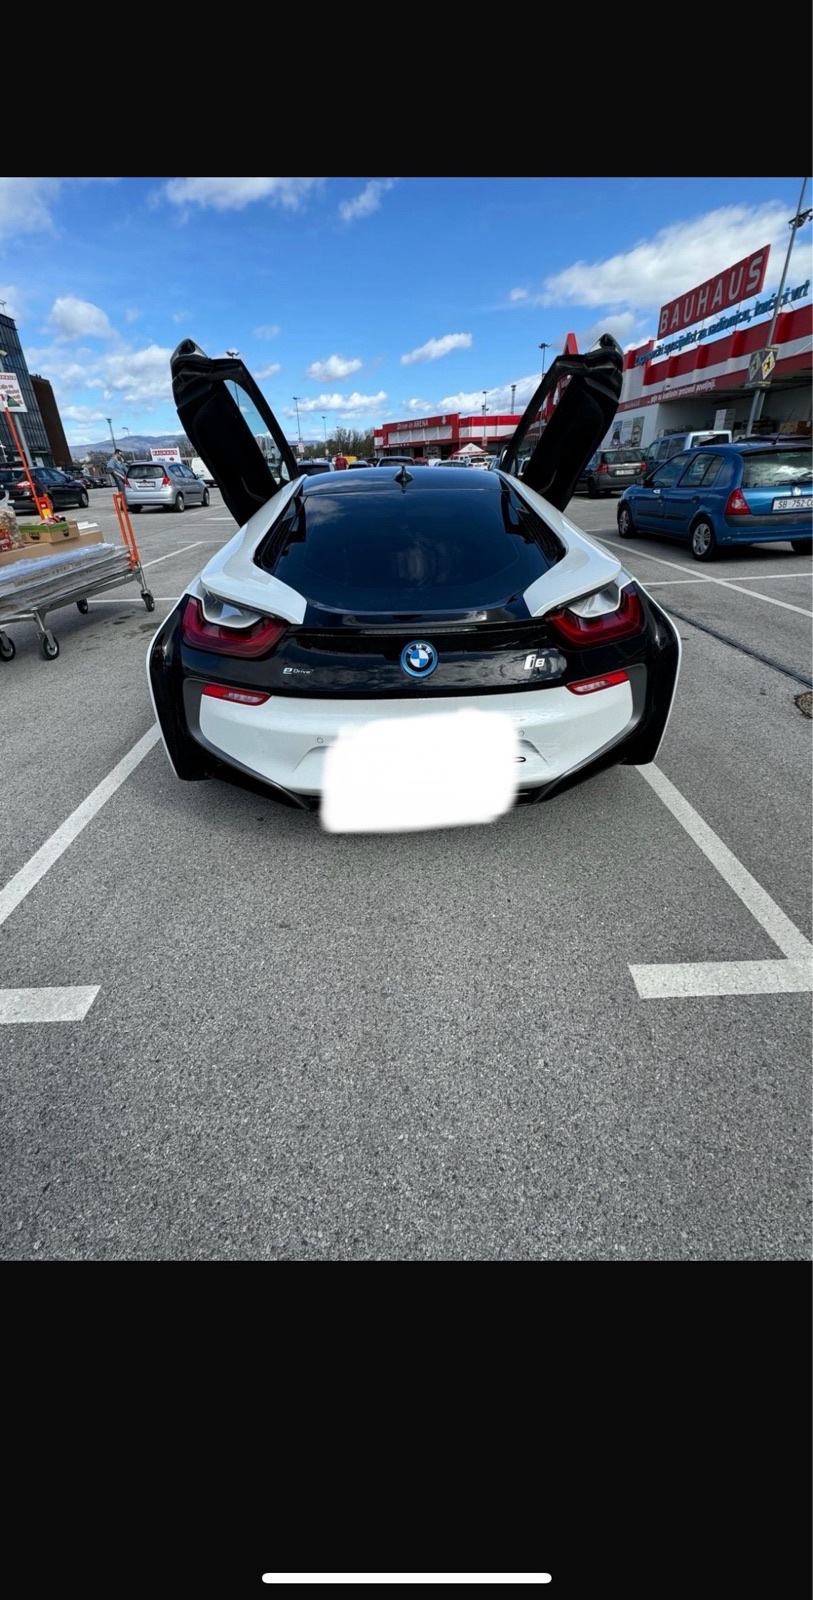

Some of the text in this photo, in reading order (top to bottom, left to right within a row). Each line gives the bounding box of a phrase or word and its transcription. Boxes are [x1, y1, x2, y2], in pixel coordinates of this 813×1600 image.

[659, 255, 763, 334] BAUHAUS
[407, 643, 432, 654] BMW
[524, 654, 546, 670] i8
